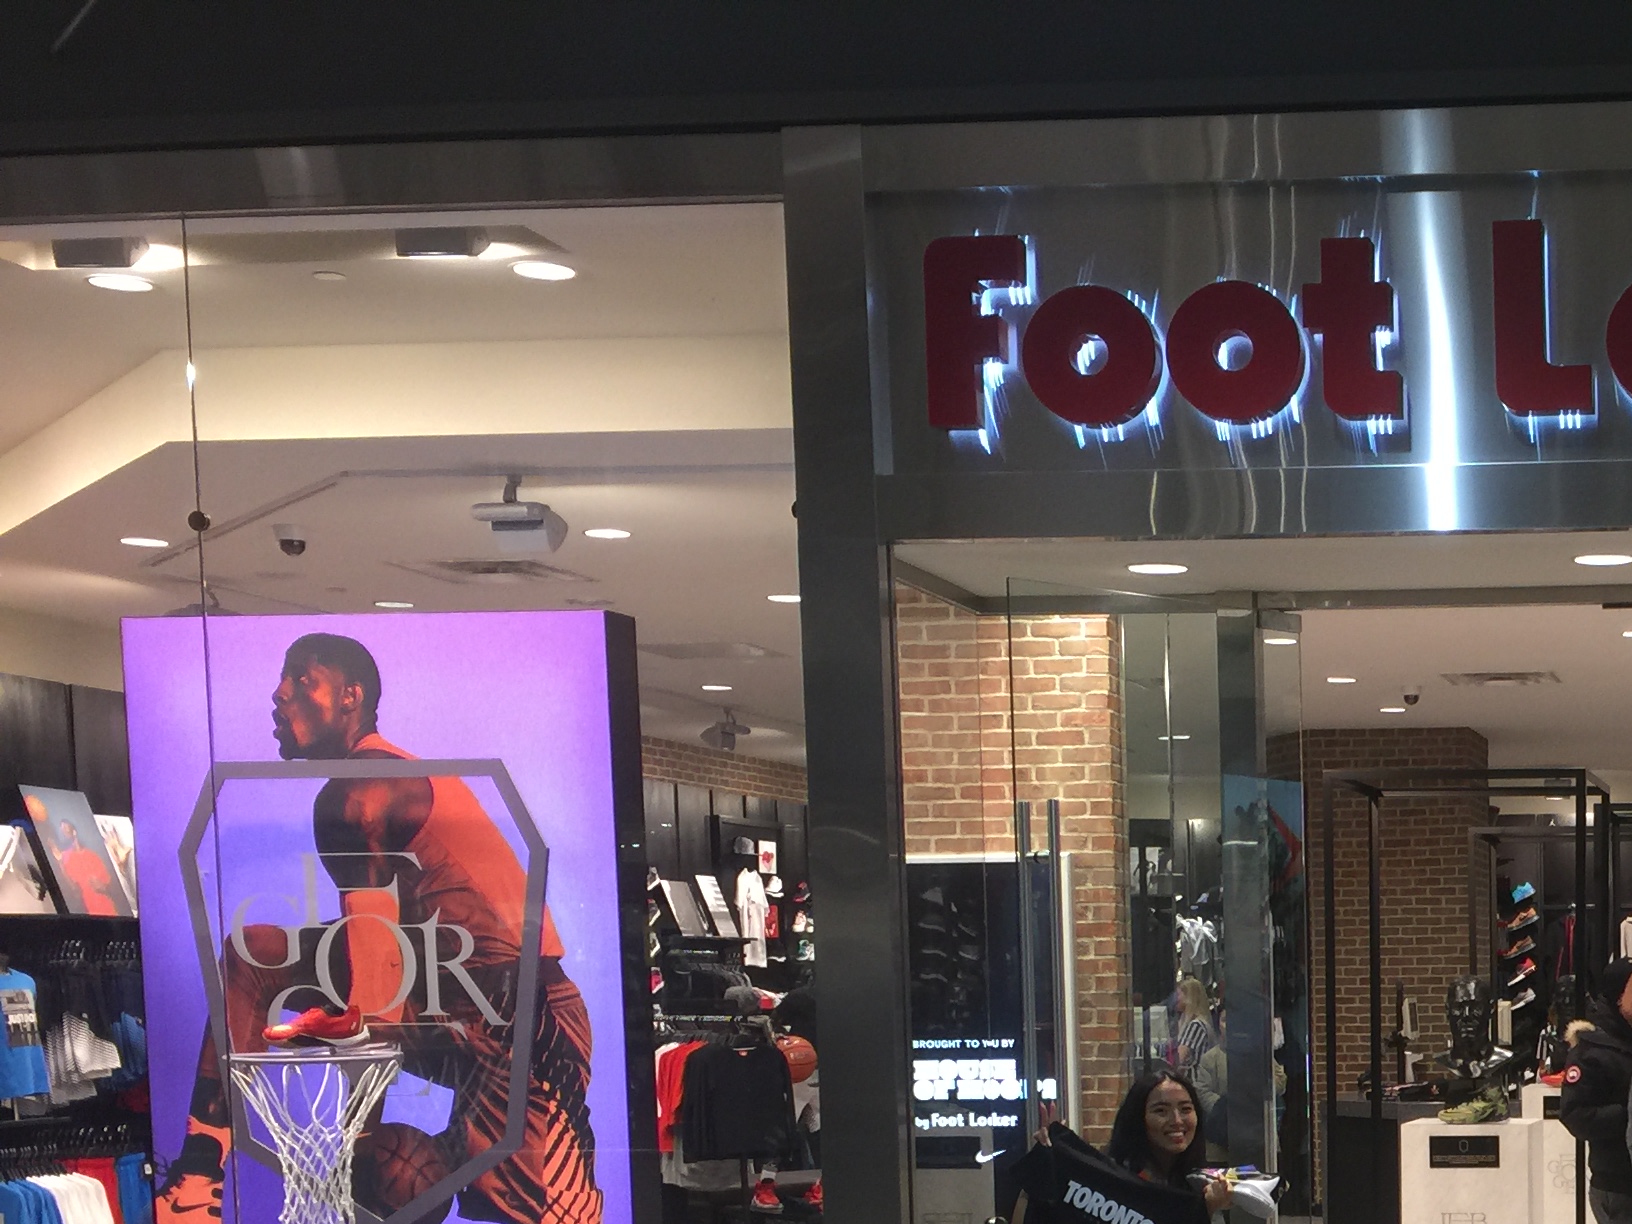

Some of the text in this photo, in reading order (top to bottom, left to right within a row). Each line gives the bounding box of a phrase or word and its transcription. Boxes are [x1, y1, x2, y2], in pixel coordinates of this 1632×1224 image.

[925, 234, 1402, 430] Foot
[912, 1039, 962, 1049] BROUGHT
[964, 1040, 980, 1049] TO
[1001, 1038, 1015, 1048] BY
[914, 1112, 1018, 1130] by Foot Locker
